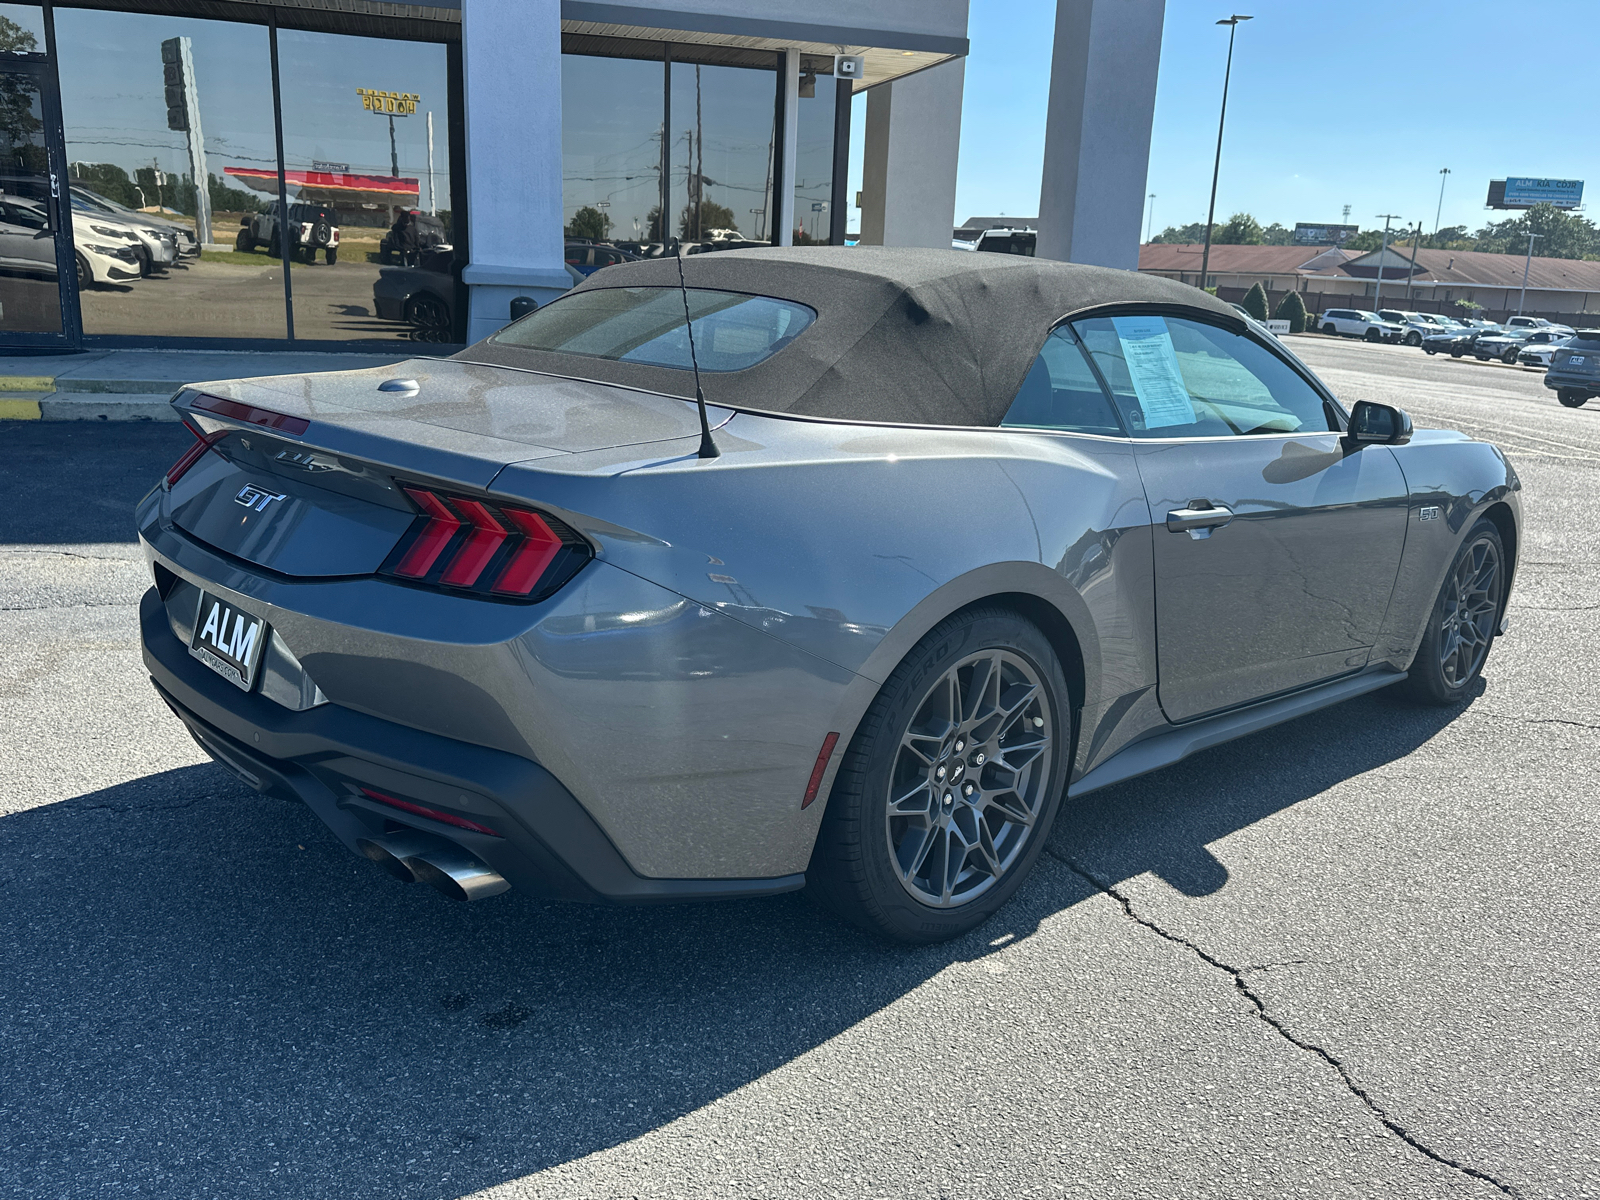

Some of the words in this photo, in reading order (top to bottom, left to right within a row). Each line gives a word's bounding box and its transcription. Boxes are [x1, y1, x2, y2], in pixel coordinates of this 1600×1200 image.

[1536, 180, 1551, 188] KIA
[1556, 181, 1577, 189] CDJR
[234, 482, 288, 513] GT
[200, 601, 259, 667] ALM
[899, 641, 949, 711] ZERO
